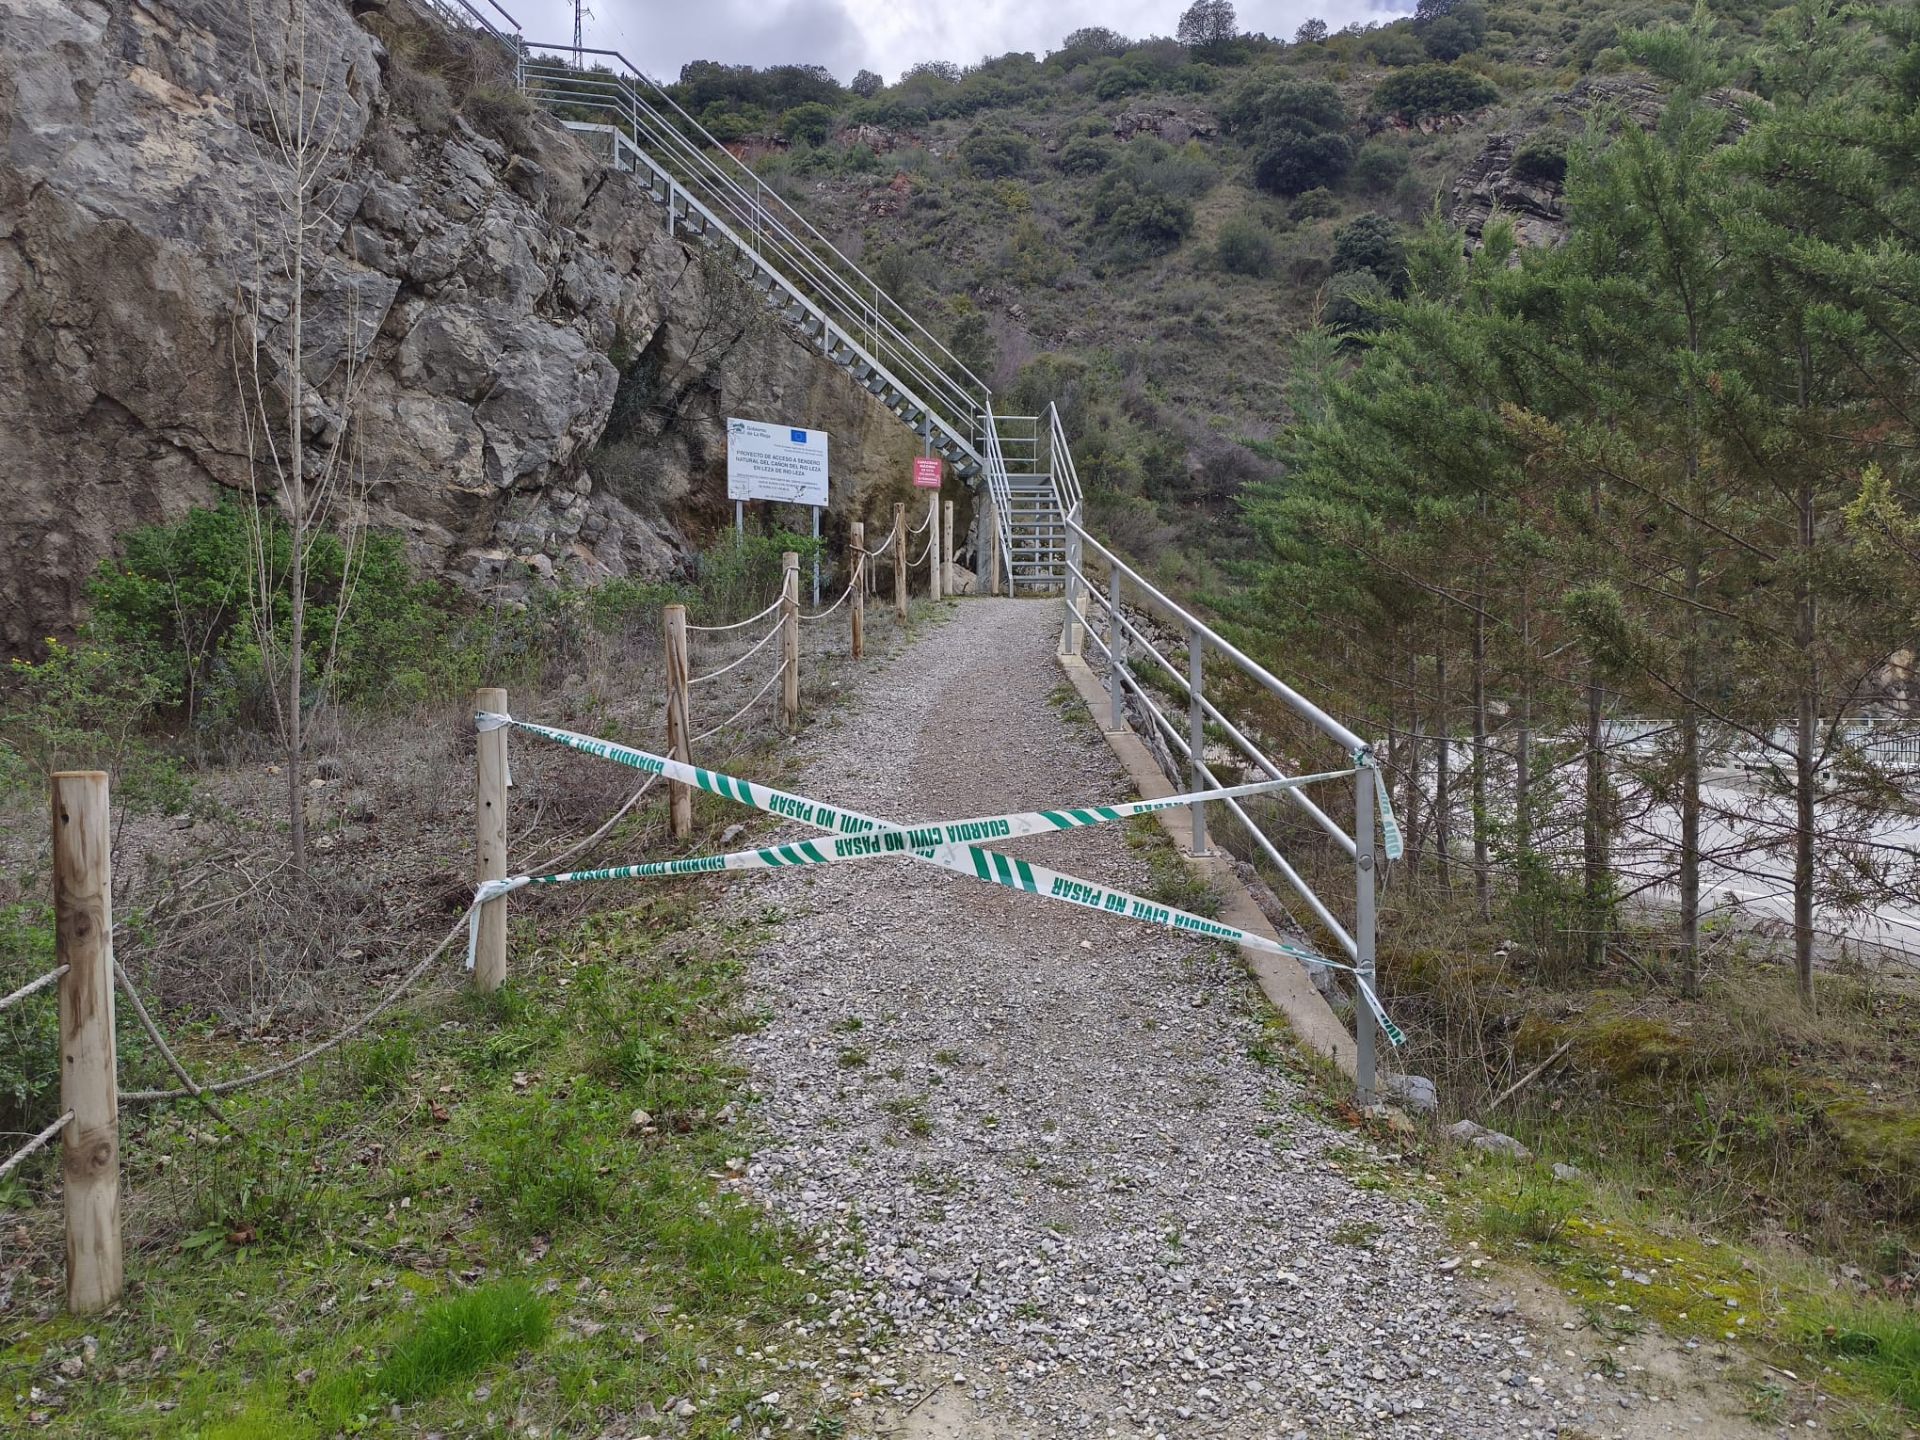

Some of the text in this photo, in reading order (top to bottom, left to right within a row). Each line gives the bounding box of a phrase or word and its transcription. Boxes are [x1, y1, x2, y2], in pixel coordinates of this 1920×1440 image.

[735, 456, 759, 465] NATURAL
[736, 450, 764, 458] PROYECTO
[772, 454, 793, 462] ACCESO
[797, 457, 821, 466] SENDERO
[576, 738, 606, 758] CIVIL
[610, 747, 665, 775] GUARDIA
[768, 793, 814, 824] PASAR
[816, 807, 836, 829] NO
[834, 818, 1011, 857] GUARDIA CIVIL NO PASAR
[670, 854, 726, 873] GUARDIA
[1050, 876, 1103, 907] PASAR
[1104, 892, 1128, 914] NO
[1131, 900, 1170, 926] CIVIL
